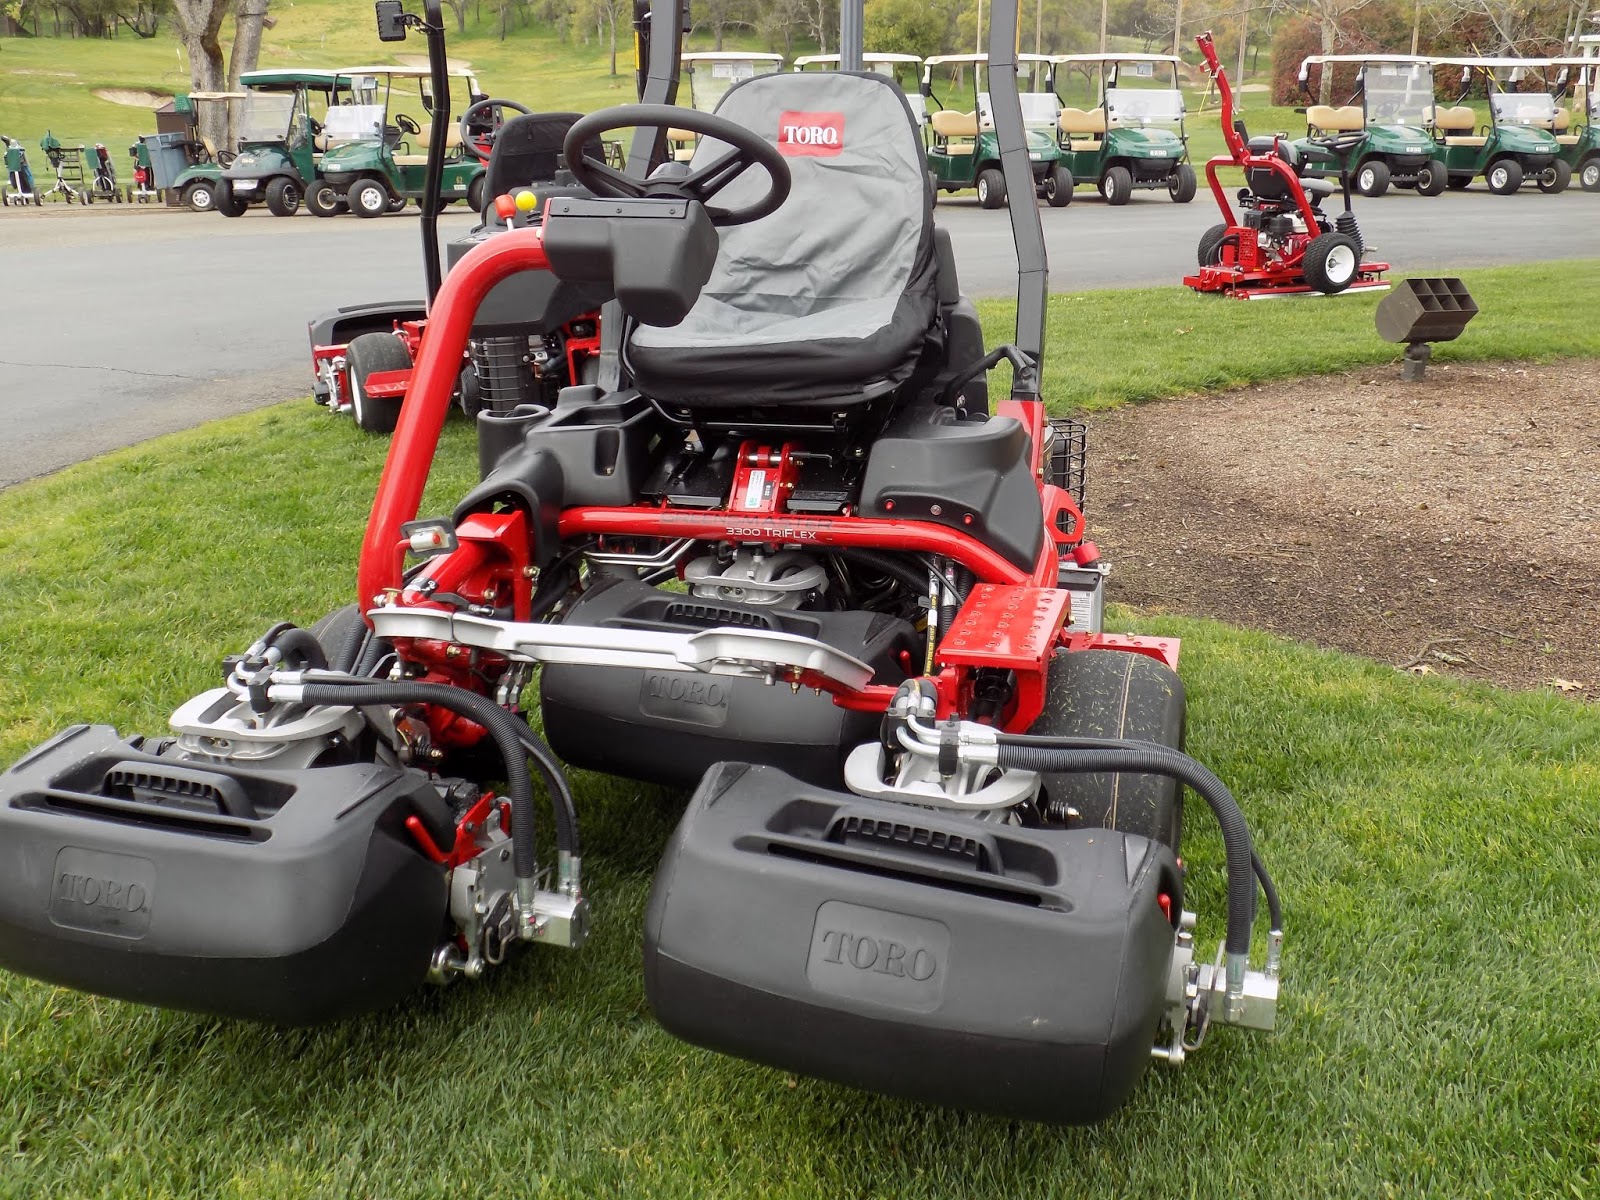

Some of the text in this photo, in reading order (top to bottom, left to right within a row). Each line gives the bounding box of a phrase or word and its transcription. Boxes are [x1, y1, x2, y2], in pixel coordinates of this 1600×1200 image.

[783, 125, 838, 145] TORO
[726, 527, 761, 536] 3300
[649, 675, 727, 709] TORO
[60, 872, 148, 913] TORO
[822, 930, 937, 982] TORO
